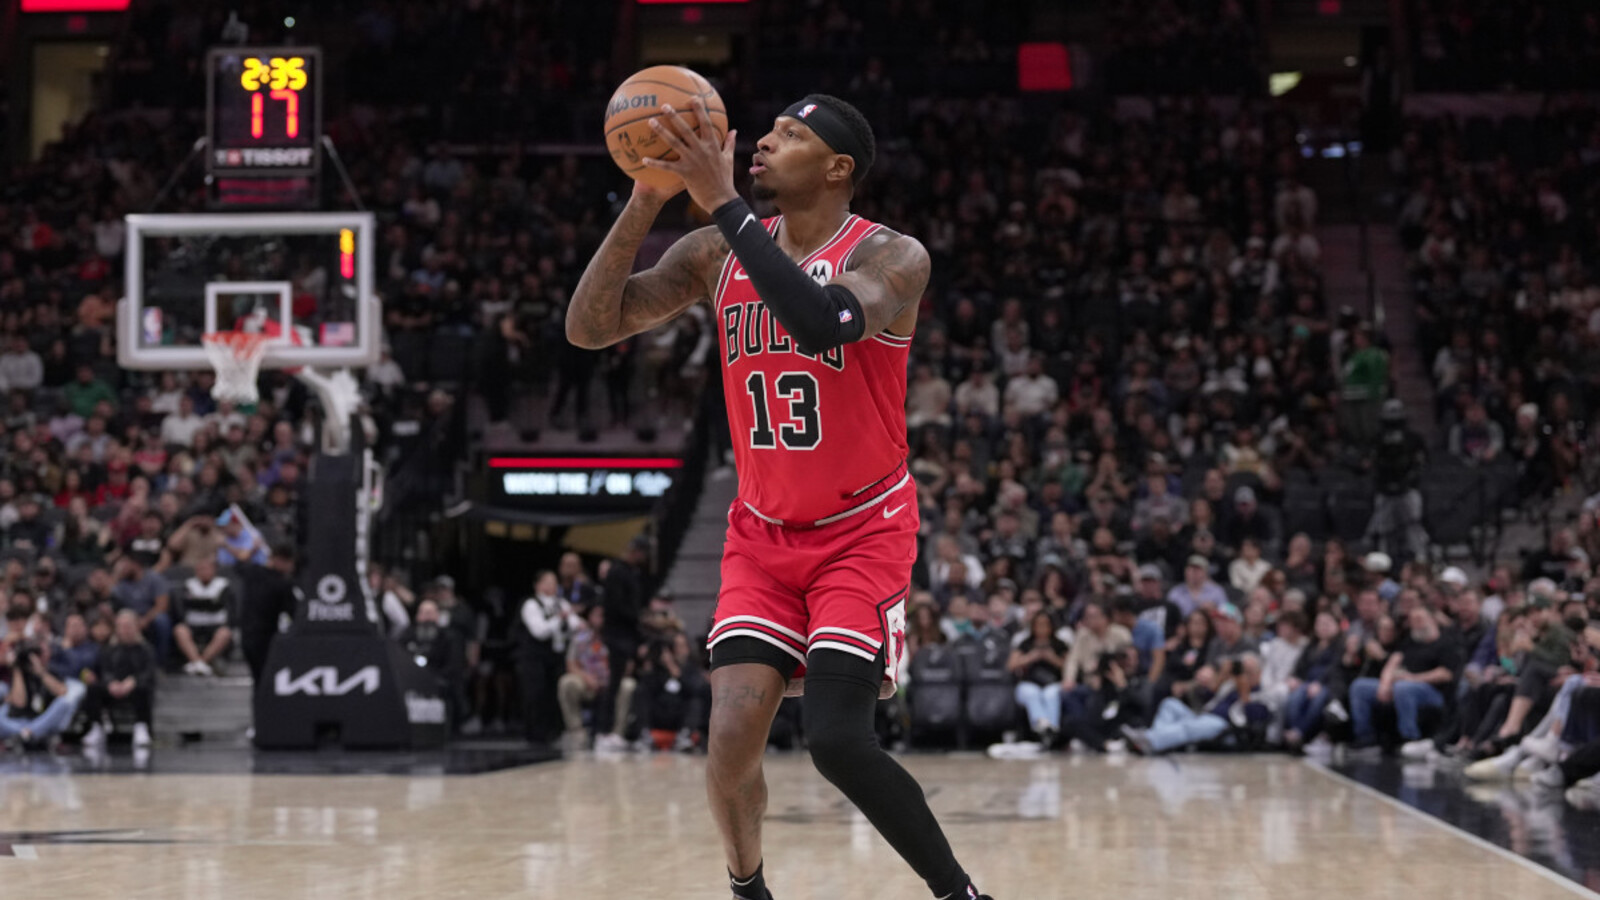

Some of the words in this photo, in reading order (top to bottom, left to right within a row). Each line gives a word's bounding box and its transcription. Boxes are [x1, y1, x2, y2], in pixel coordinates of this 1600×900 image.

[241, 57, 307, 91] 2:35
[252, 89, 298, 139] 17
[243, 149, 312, 166] TISSOT
[724, 301, 844, 372] BUL
[746, 371, 822, 450] 13
[274, 666, 380, 696] KIA
